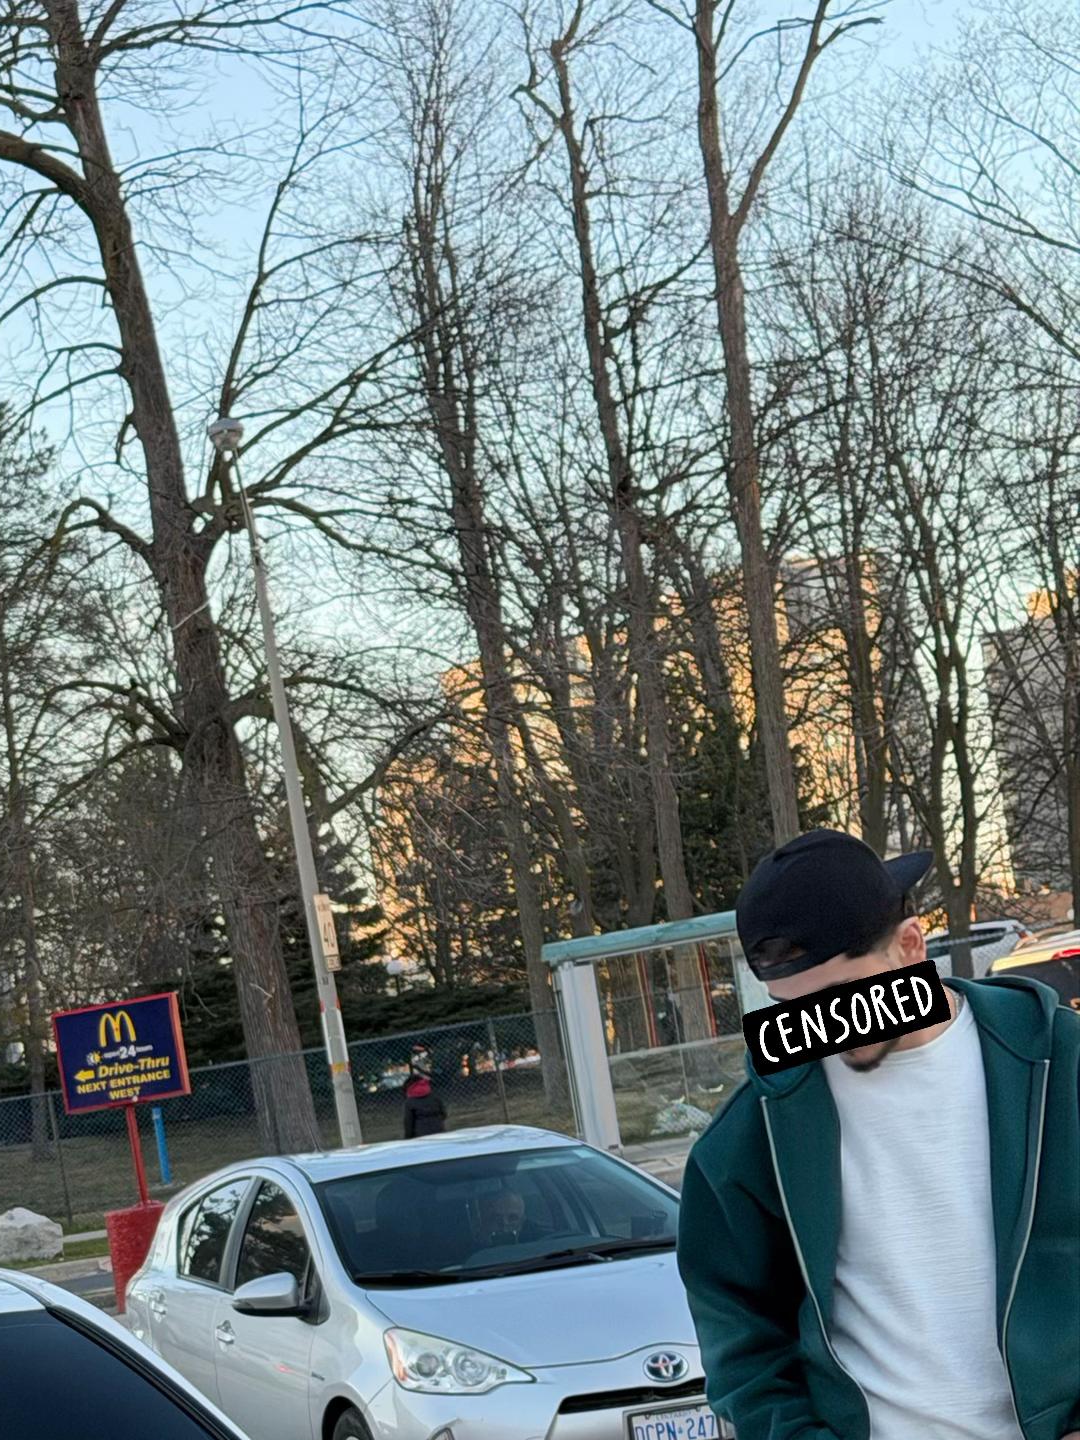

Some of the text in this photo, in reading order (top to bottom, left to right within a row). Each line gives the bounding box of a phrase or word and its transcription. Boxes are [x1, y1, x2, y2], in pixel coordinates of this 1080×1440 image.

[323, 921, 336, 948] 40
[119, 1045, 137, 1059] 24
[98, 1056, 170, 1078] Drive-Thru
[76, 1069, 171, 1095] NEXT ENTRANCE
[109, 1086, 141, 1100] WEST
[686, 1415, 715, 1440] 247
